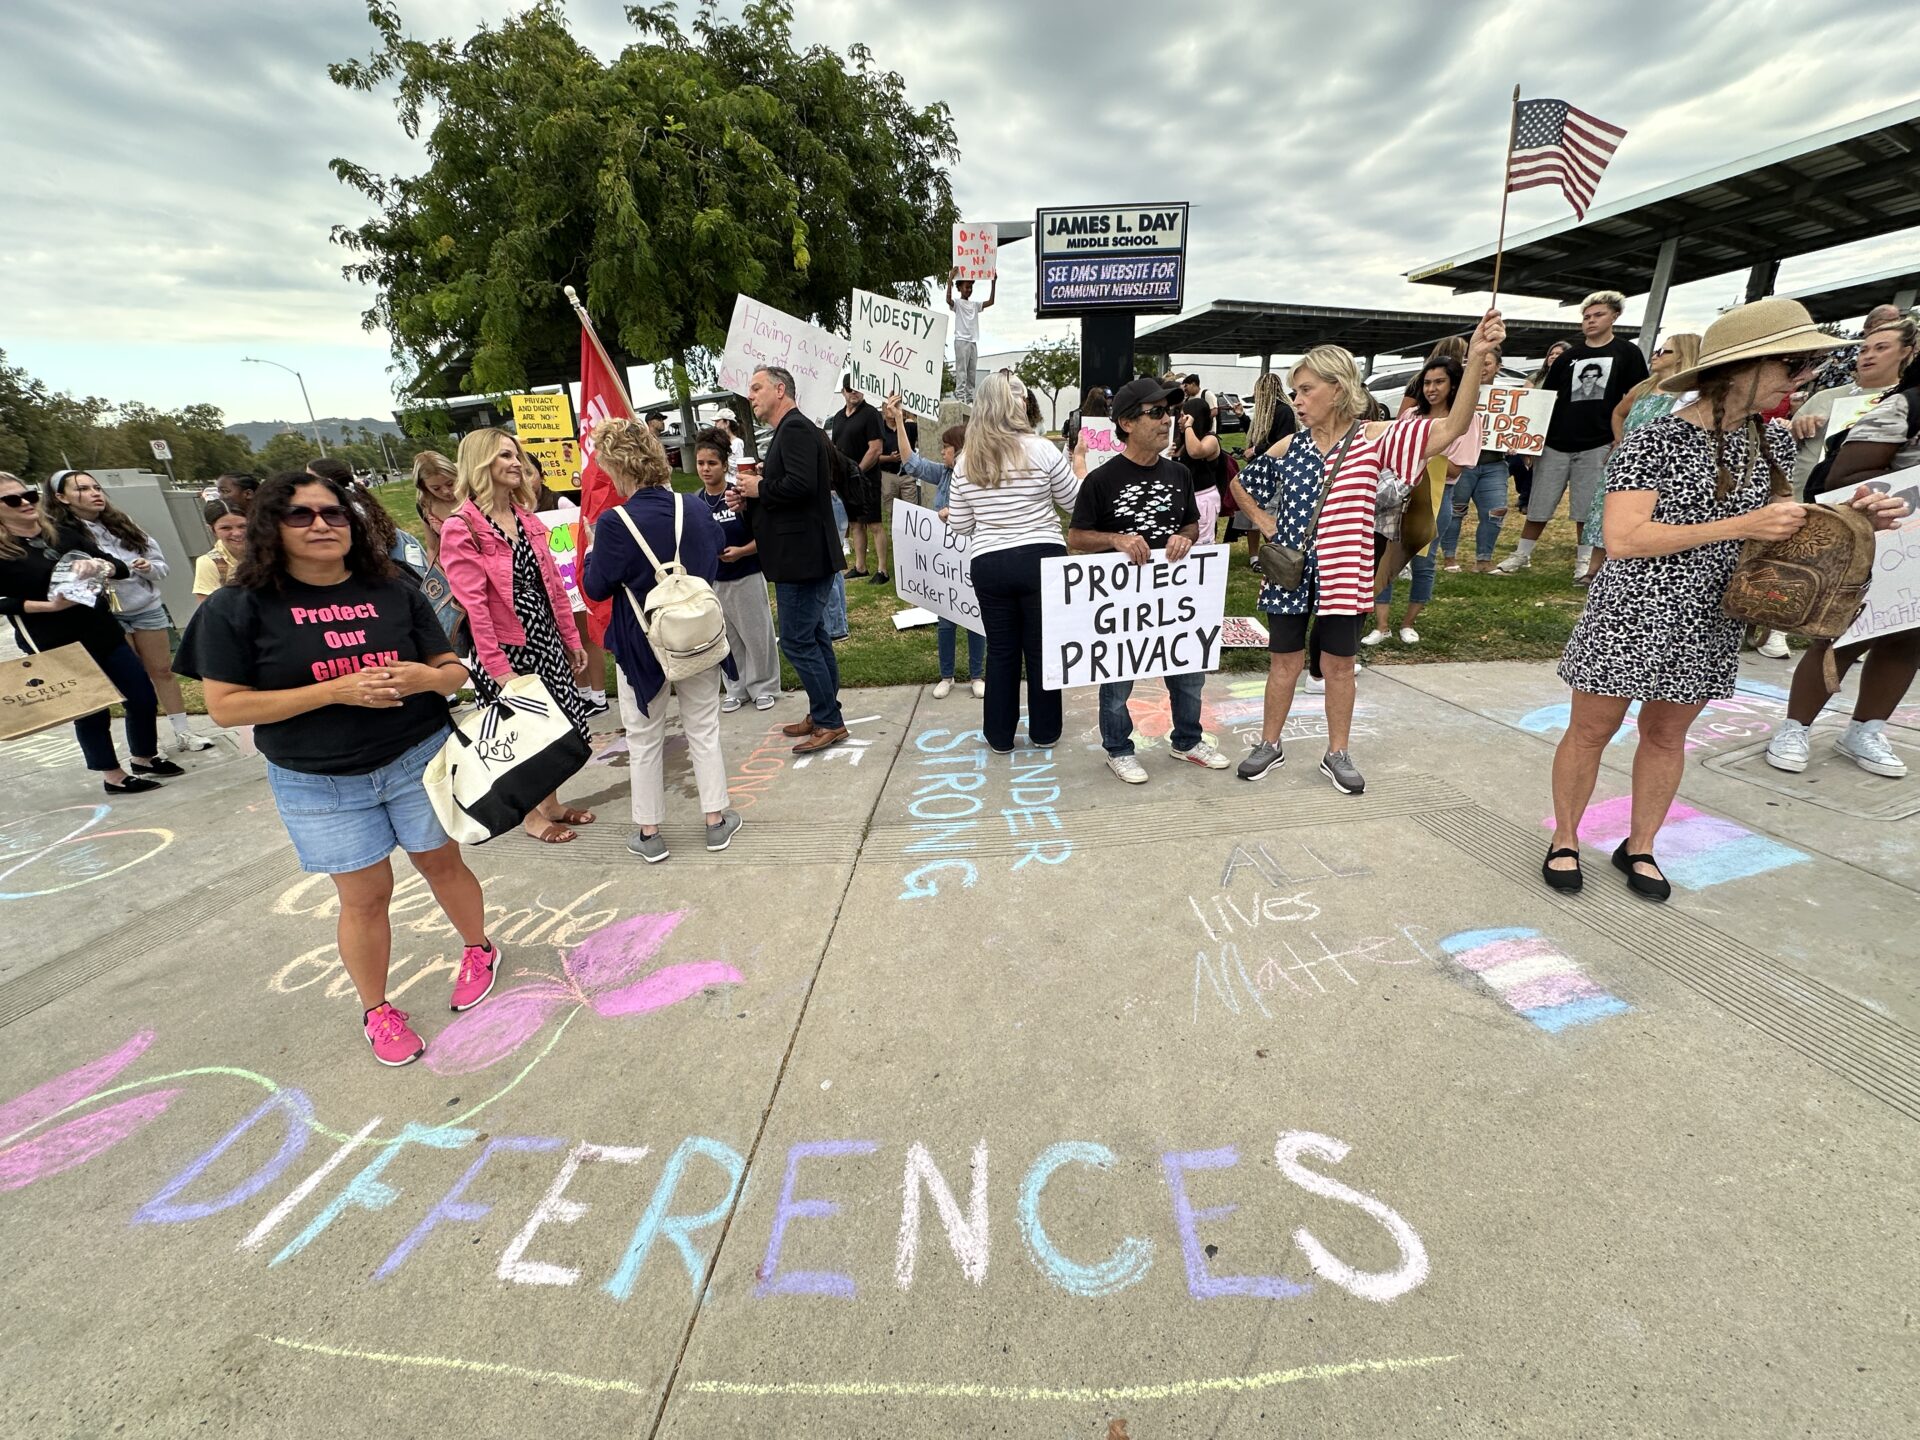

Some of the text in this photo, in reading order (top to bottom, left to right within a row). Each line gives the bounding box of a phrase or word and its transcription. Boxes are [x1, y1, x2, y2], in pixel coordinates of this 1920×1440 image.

[1047, 212, 1179, 236] JAMES L. DAY
[1066, 235, 1158, 249] MIDDLE SCHOOL
[1047, 261, 1176, 283] SEE DMS WEBSITE FOR
[1051, 281, 1172, 299] COMMUNITY NEWSLETTER
[743, 304, 841, 368] Having a voice
[859, 294, 935, 340] MODESTY
[743, 340, 766, 362] does
[792, 362, 819, 380] make
[880, 339, 918, 369] NOT
[926, 359, 934, 376] a
[524, 397, 553, 405] PRIVACY
[852, 360, 940, 417] MENTAL DISORDER
[1479, 413, 1530, 433] IDS
[1496, 433, 1544, 451] KIDS
[905, 510, 972, 553] NO BO
[932, 552, 974, 588] Girls
[1063, 551, 1218, 605] PROTECT
[900, 565, 981, 618] Locker Roo
[290, 602, 379, 625] Protect
[1094, 596, 1196, 635] GIRLS
[323, 629, 367, 649] Our
[1060, 625, 1221, 685] PRIVACY
[2, 679, 77, 705] SECRETS
[474, 731, 519, 772] Rosie
[1000, 716, 1074, 871] ENDER
[898, 728, 988, 901] STRONG
[1220, 842, 1376, 888] ALL
[129, 1088, 1431, 1303] DIFFERENCES
